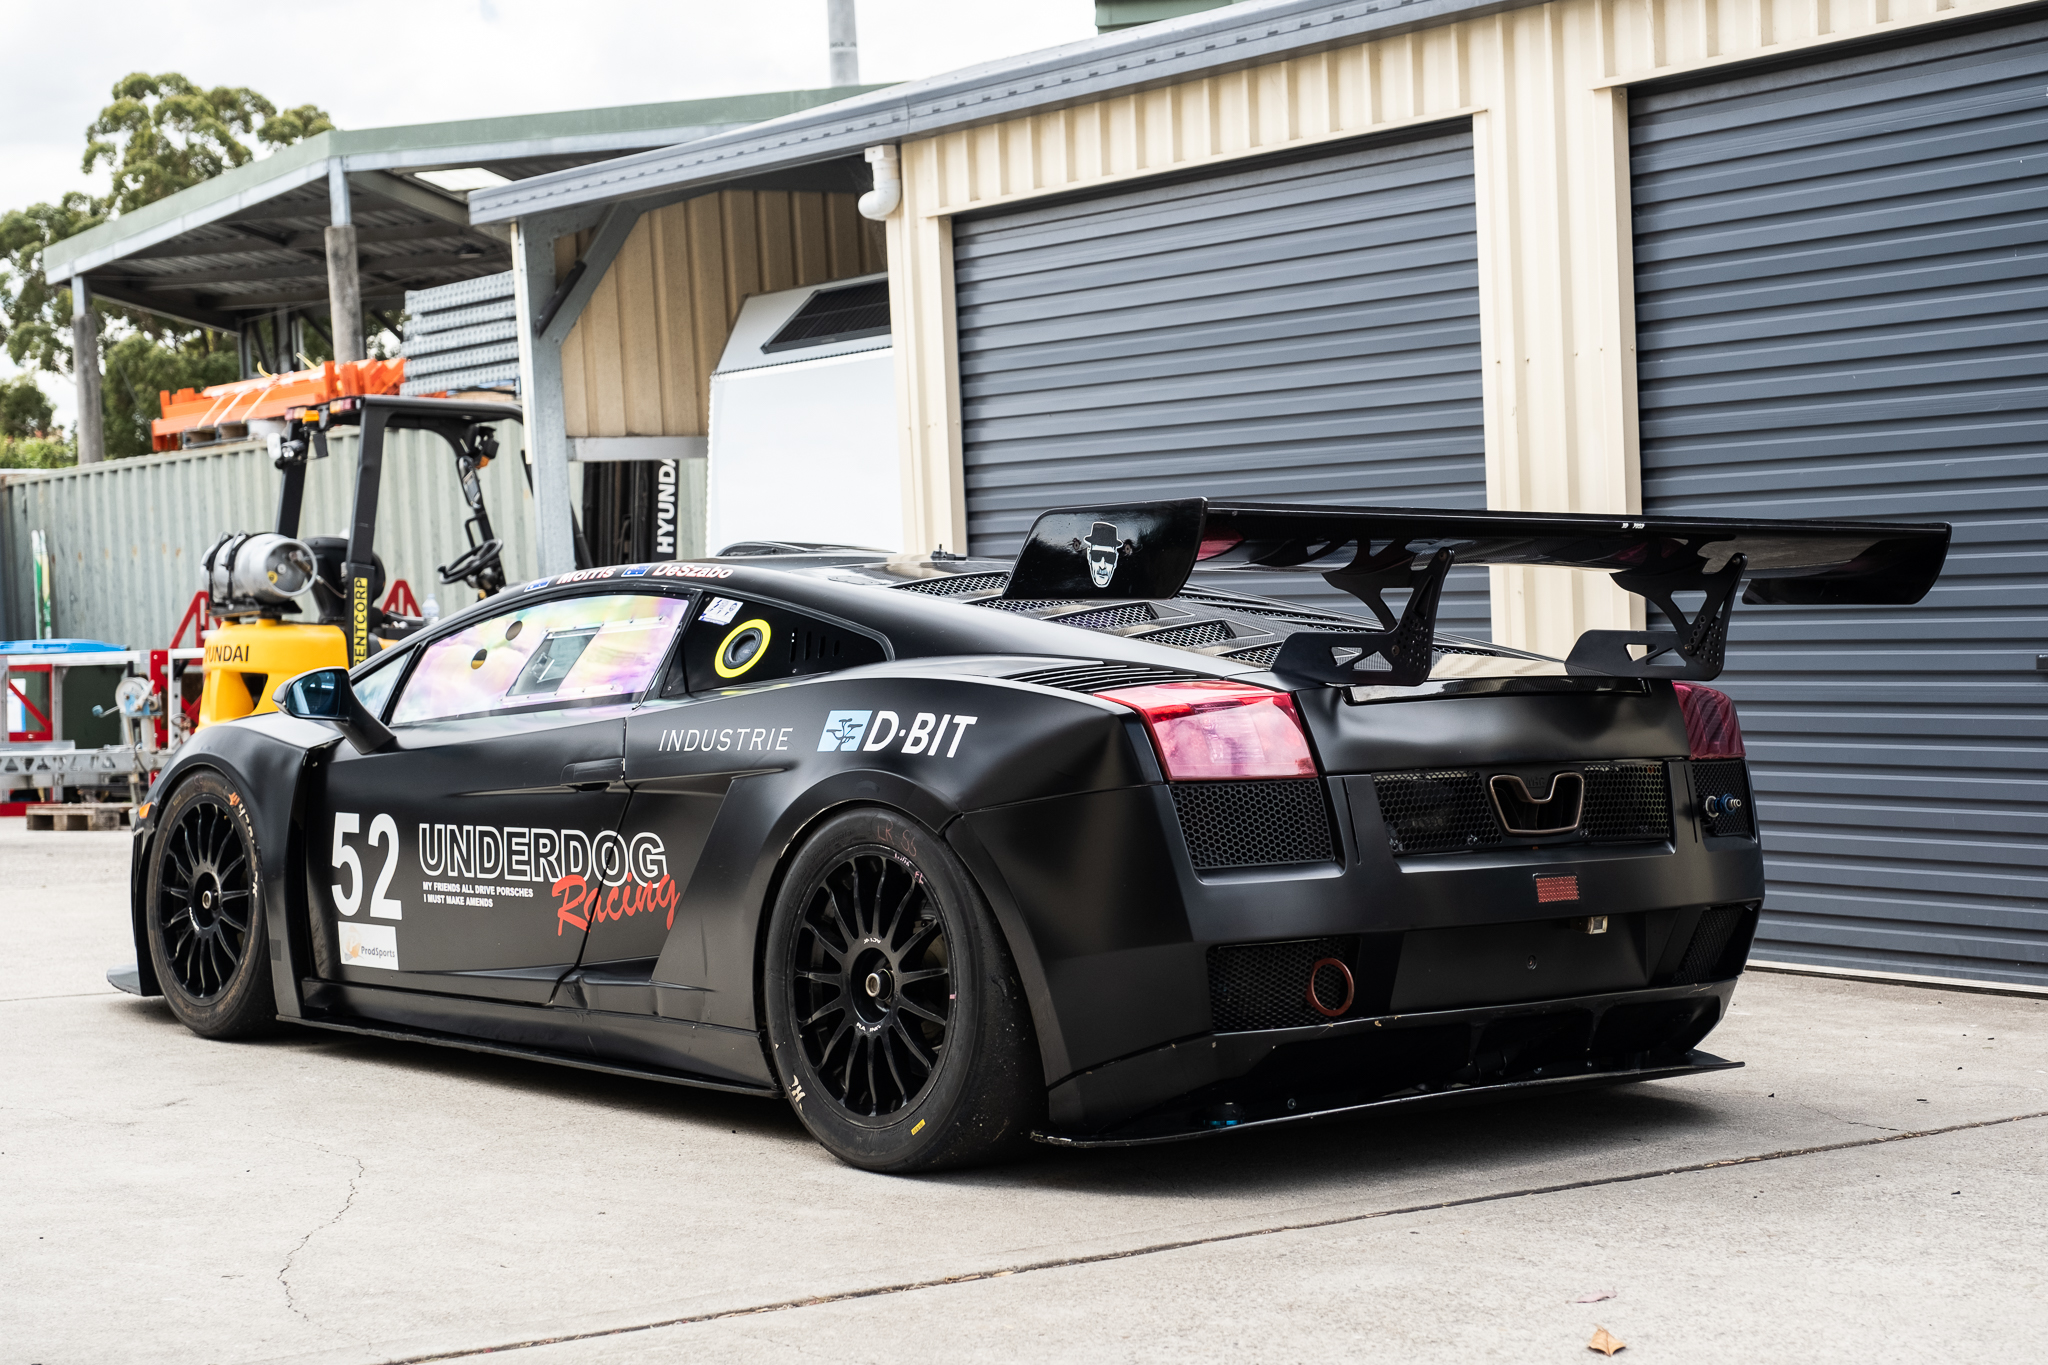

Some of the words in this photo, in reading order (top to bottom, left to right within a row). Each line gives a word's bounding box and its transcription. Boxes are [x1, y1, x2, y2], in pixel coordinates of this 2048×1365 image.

[556, 566, 617, 585] Morris
[652, 563, 734, 579] DeSzabo
[658, 727, 794, 752] INDUSTRIE
[331, 811, 402, 920] 52
[418, 823, 668, 888] UNDERDOG
[422, 881, 433, 891] MY
[433, 882, 460, 893] FRIENDS
[461, 884, 474, 894] ALL
[475, 885, 495, 896] DRIVE
[496, 886, 534, 898] PORSCHES
[427, 894, 445, 904] MUST
[446, 895, 465, 906] MAKE
[465, 897, 494, 908] AMENDS
[551, 872, 680, 936] Racing
[361, 945, 396, 959] ProdSports
